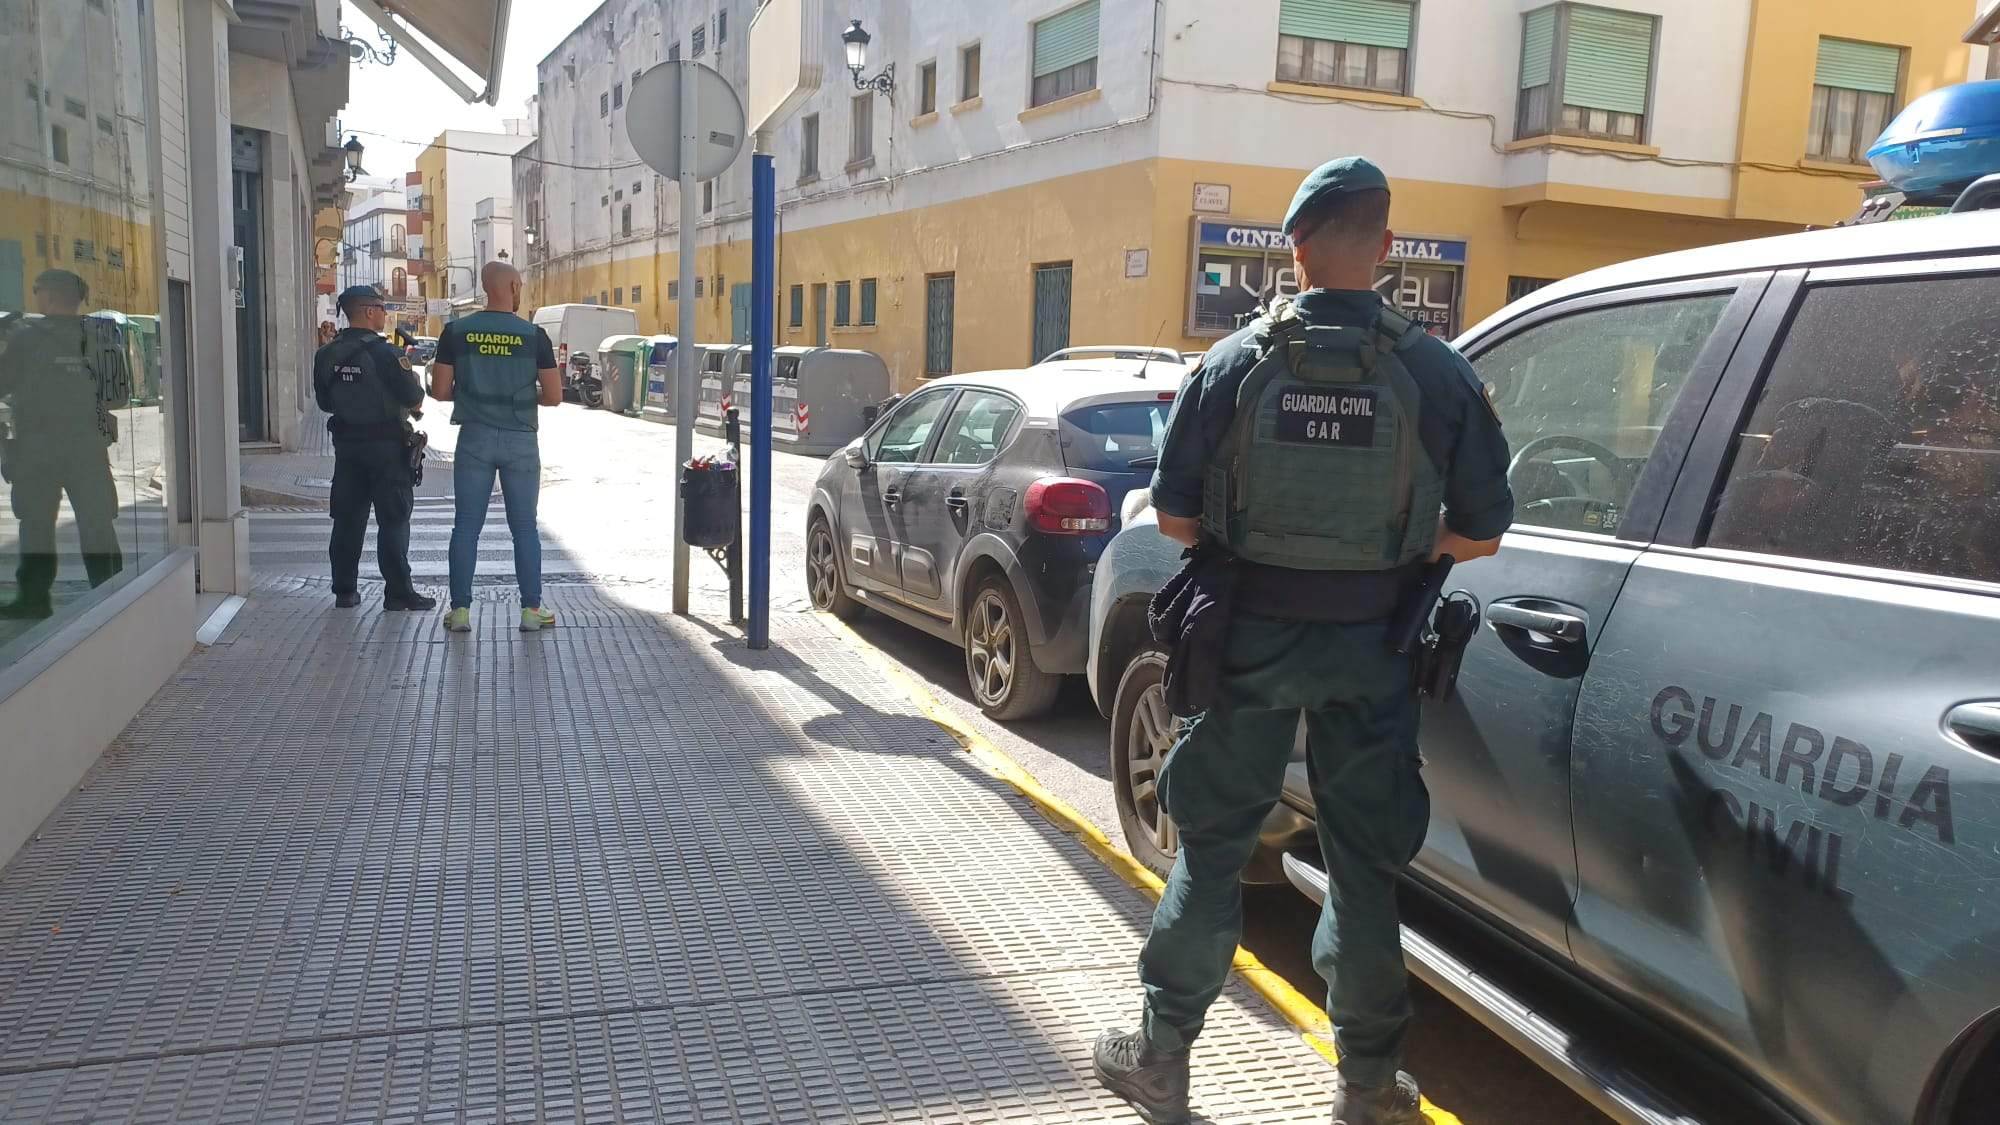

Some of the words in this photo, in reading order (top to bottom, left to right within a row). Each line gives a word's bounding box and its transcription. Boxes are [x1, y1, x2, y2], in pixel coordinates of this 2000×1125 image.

[1389, 240, 1442, 260] RIAL
[466, 332, 523, 346] GUARDIA
[479, 344, 513, 356] CIVIL
[1282, 393, 1337, 414] GUARDIA
[1340, 397, 1373, 417] CIVIL
[1651, 685, 1955, 845] GUARDIA
